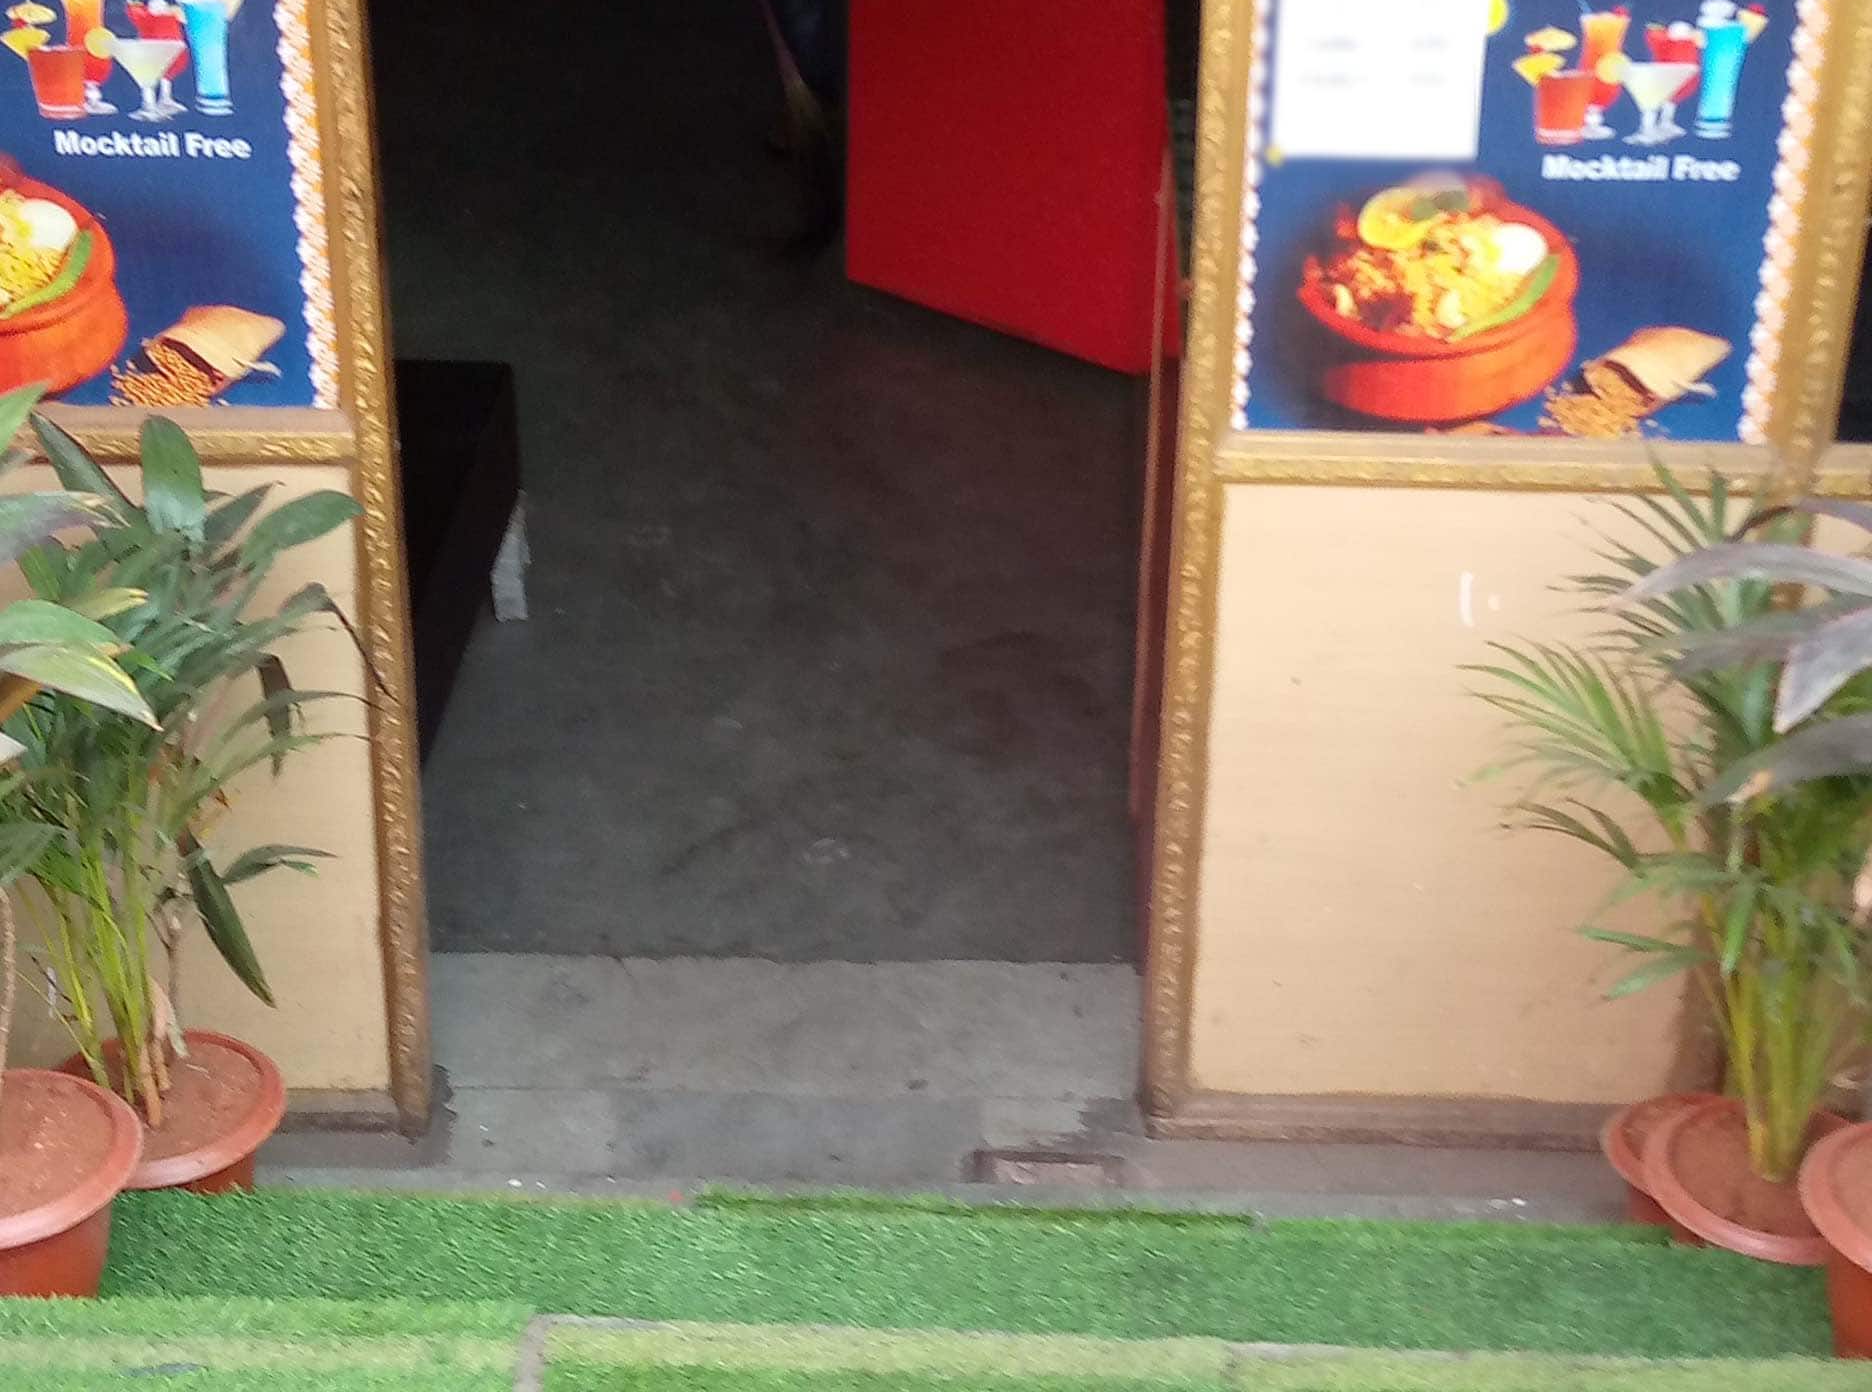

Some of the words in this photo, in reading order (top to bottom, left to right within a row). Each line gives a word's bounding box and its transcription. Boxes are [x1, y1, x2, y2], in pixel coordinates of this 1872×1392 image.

[54, 129, 180, 158] Mocktail
[184, 131, 252, 158] Free
[1541, 154, 1669, 181] Mocktail
[1672, 154, 1742, 182] Free
